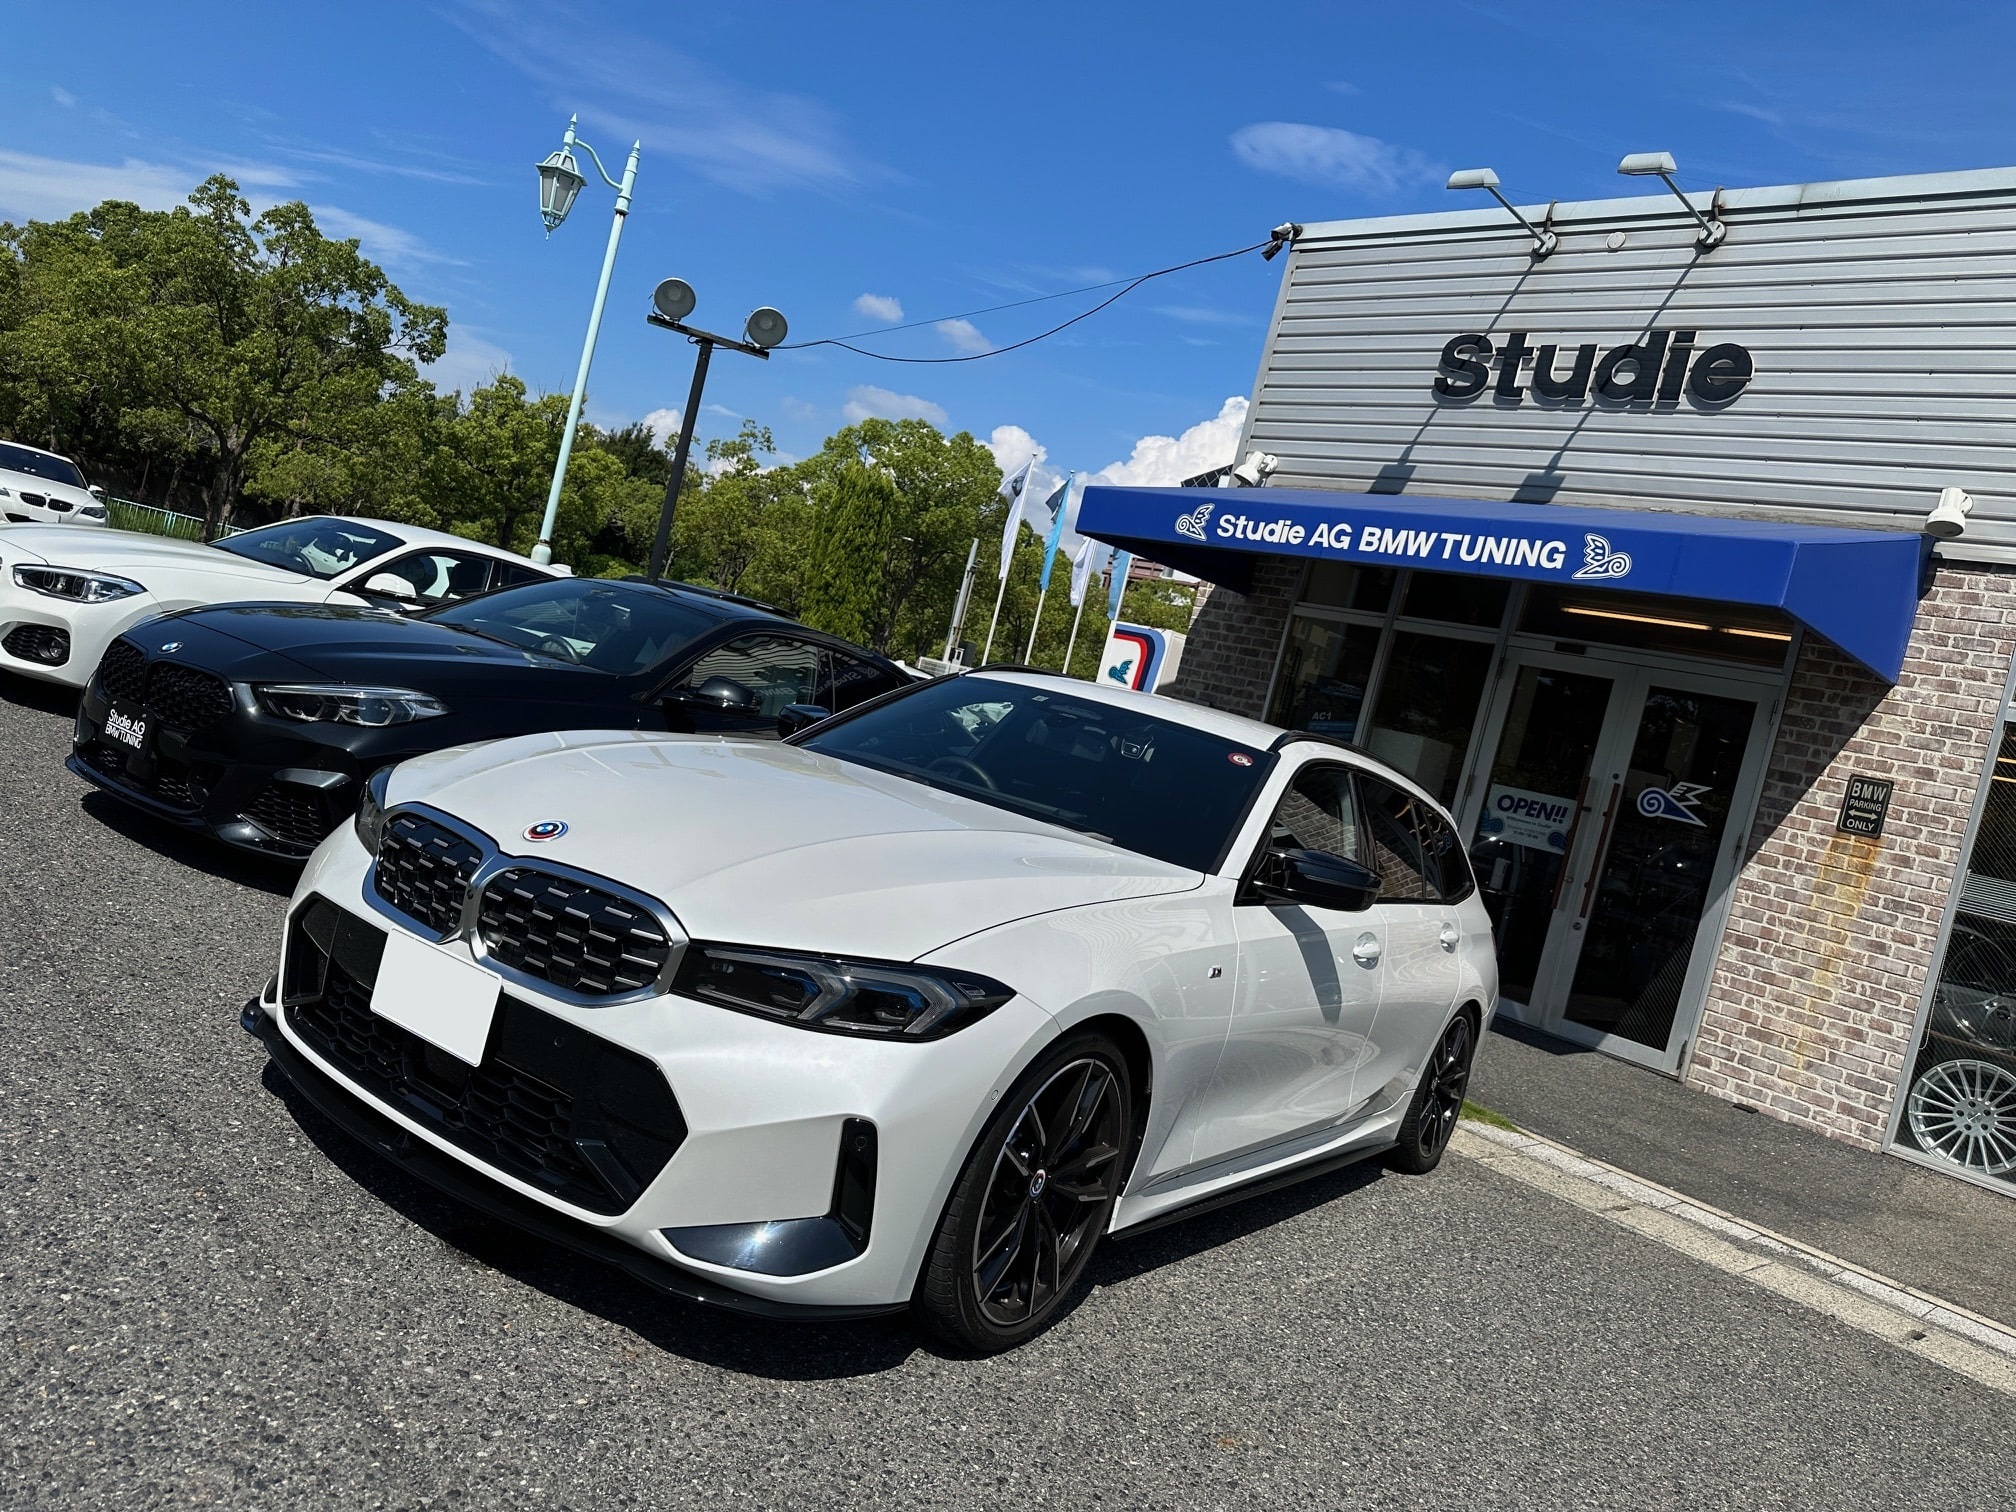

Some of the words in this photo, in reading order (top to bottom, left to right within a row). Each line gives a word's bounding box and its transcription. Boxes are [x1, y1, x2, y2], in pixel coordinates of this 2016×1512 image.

[1434, 330, 1753, 404] Studie
[1216, 514, 1305, 545] Studie
[1308, 522, 1353, 550] AG
[1358, 526, 1439, 558] BMW
[1441, 532, 1567, 570] TUNING
[105, 723, 120, 739] BMW
[131, 719, 146, 735] AG
[1851, 782, 1887, 801] BMW
[1497, 794, 1569, 824] OPEN!!
[1849, 798, 1882, 811] PARKING
[1846, 818, 1874, 831] ONLY
